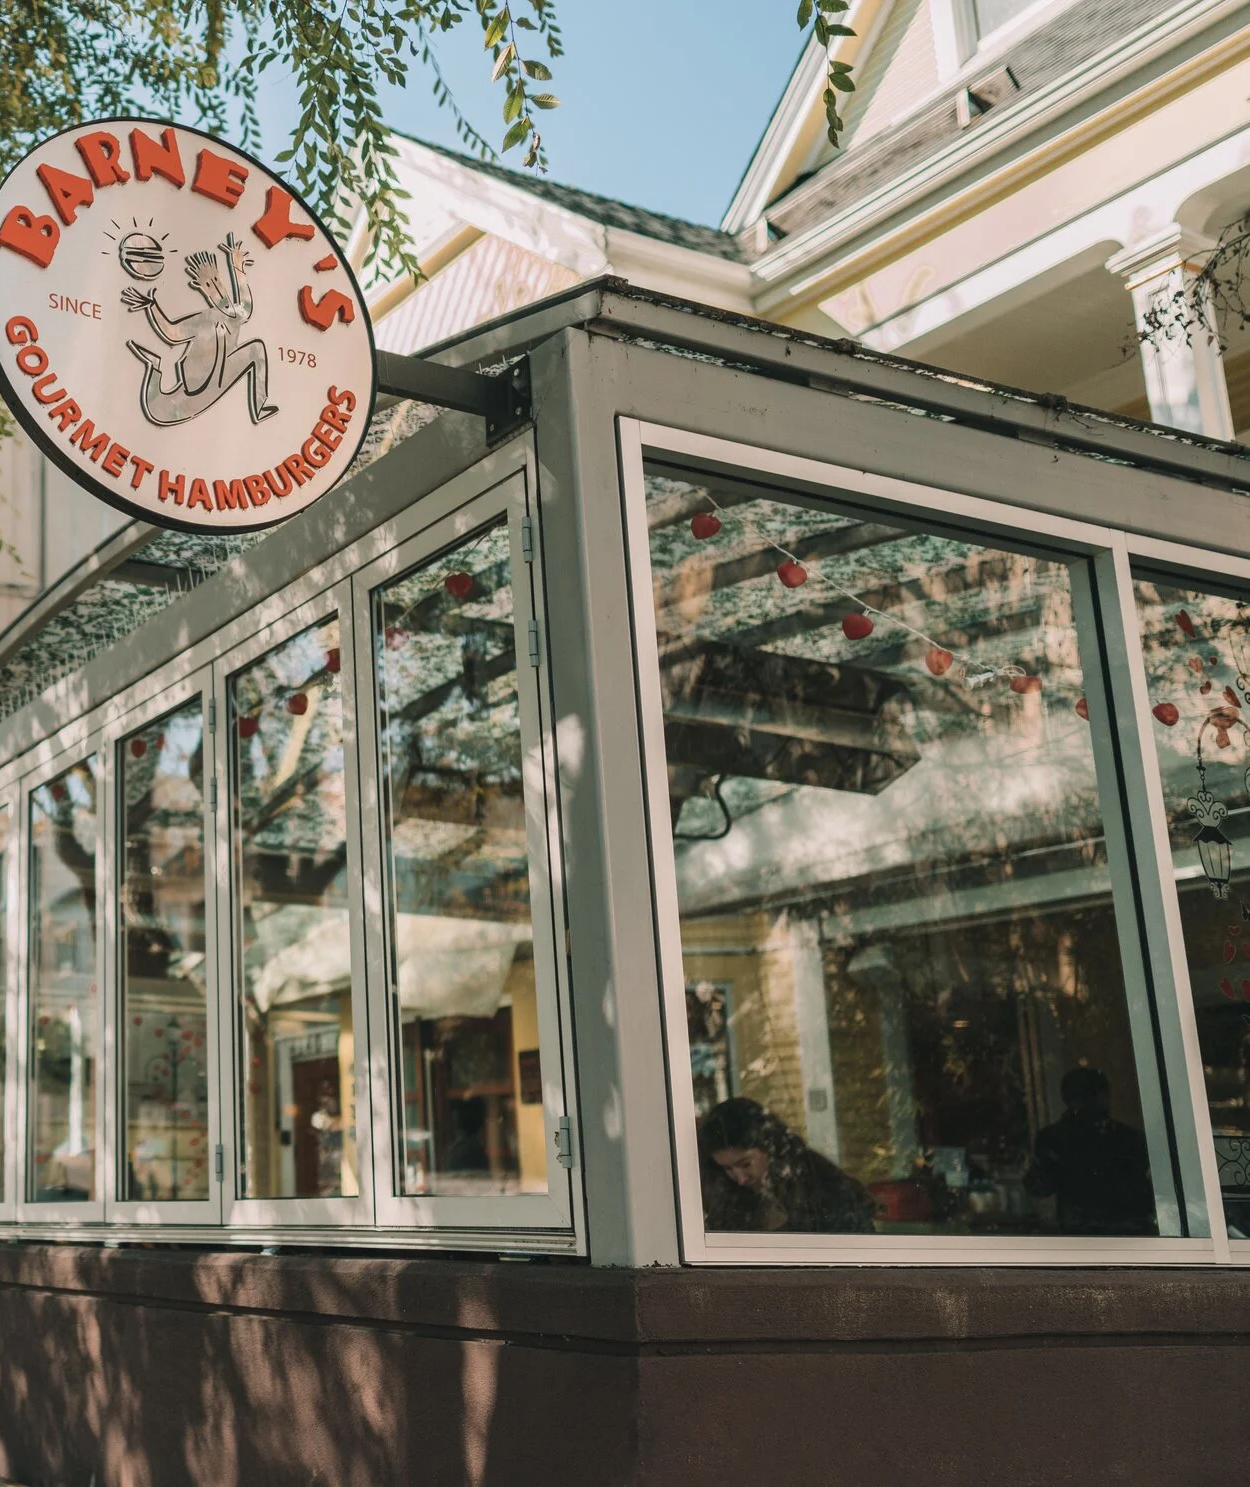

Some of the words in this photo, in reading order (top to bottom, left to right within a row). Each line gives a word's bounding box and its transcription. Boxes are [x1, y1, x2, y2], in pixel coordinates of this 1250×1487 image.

[48, 293, 102, 320] SINCE
[278, 347, 317, 369] 1978
[6, 316, 155, 490] GOURMET
[159, 385, 357, 512] HAMBURGERS
